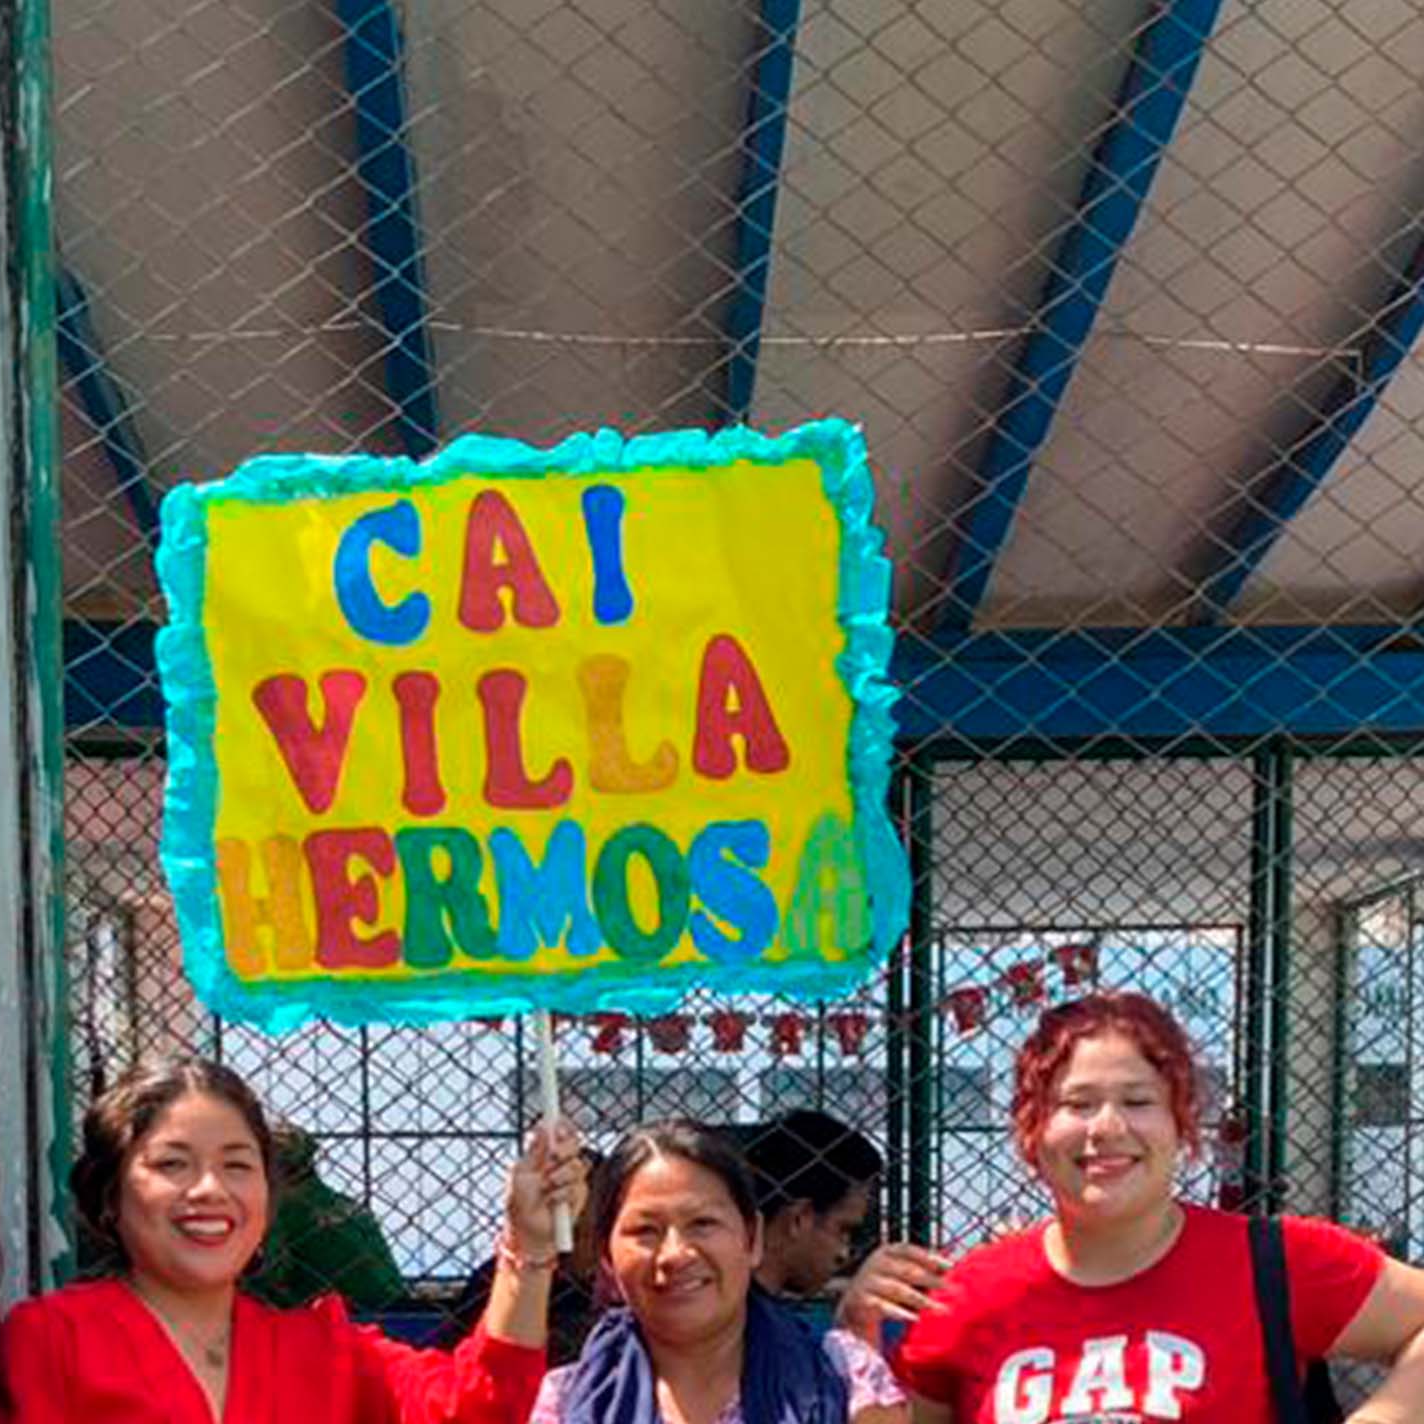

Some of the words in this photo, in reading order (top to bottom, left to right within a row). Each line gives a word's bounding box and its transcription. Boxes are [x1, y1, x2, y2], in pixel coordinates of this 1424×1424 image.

[333, 484, 633, 646] CAI
[252, 634, 790, 816] VILLA
[216, 814, 874, 977] HERMOSA
